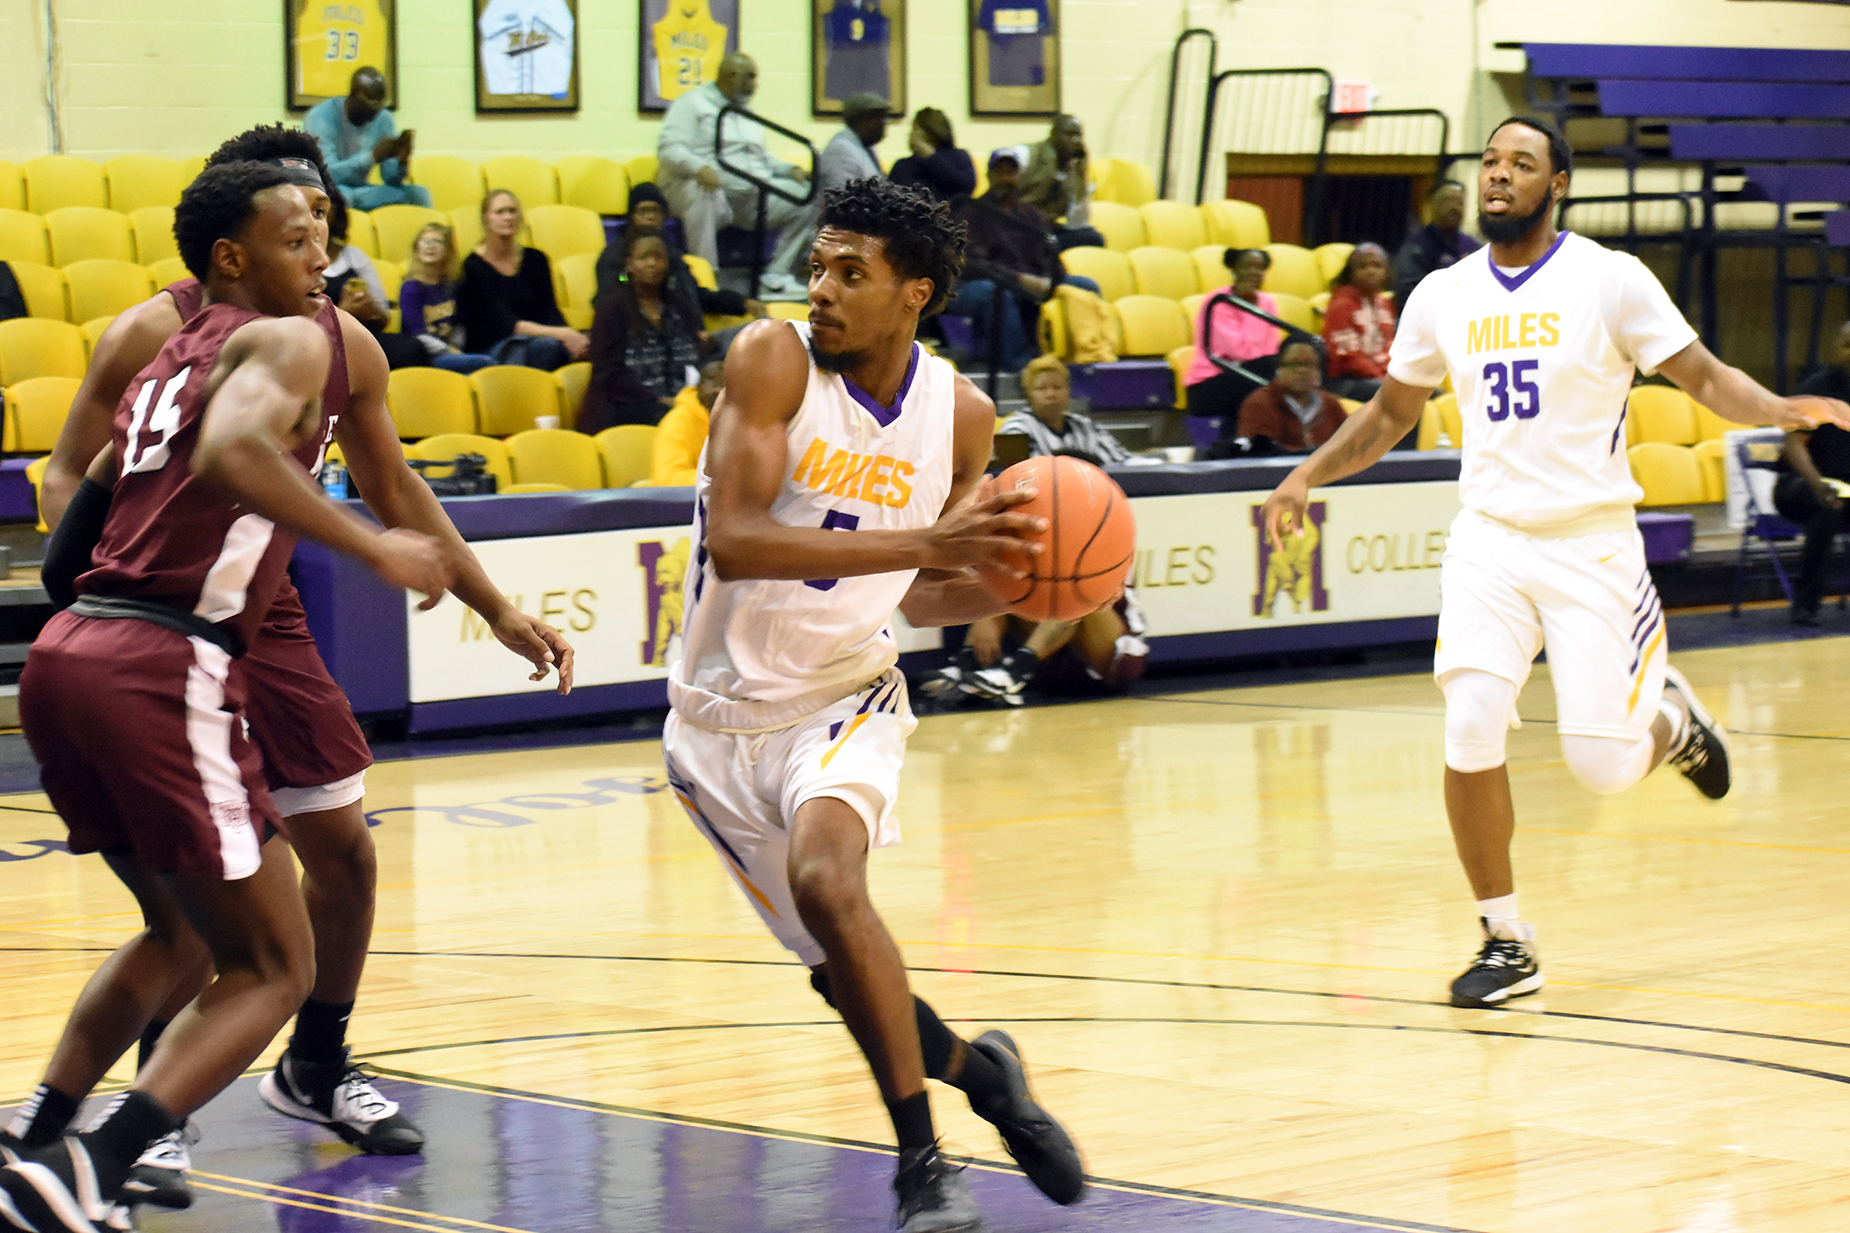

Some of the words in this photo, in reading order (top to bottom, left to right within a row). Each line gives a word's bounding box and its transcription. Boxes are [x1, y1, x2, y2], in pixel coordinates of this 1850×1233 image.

[325, 30, 361, 62] 33
[1467, 313, 1560, 355] MILES
[1483, 359, 1540, 422] 35
[121, 365, 191, 479] 15
[792, 437, 914, 510] MILES
[1133, 544, 1216, 589] ILES
[1346, 530, 1451, 575] COLLE
